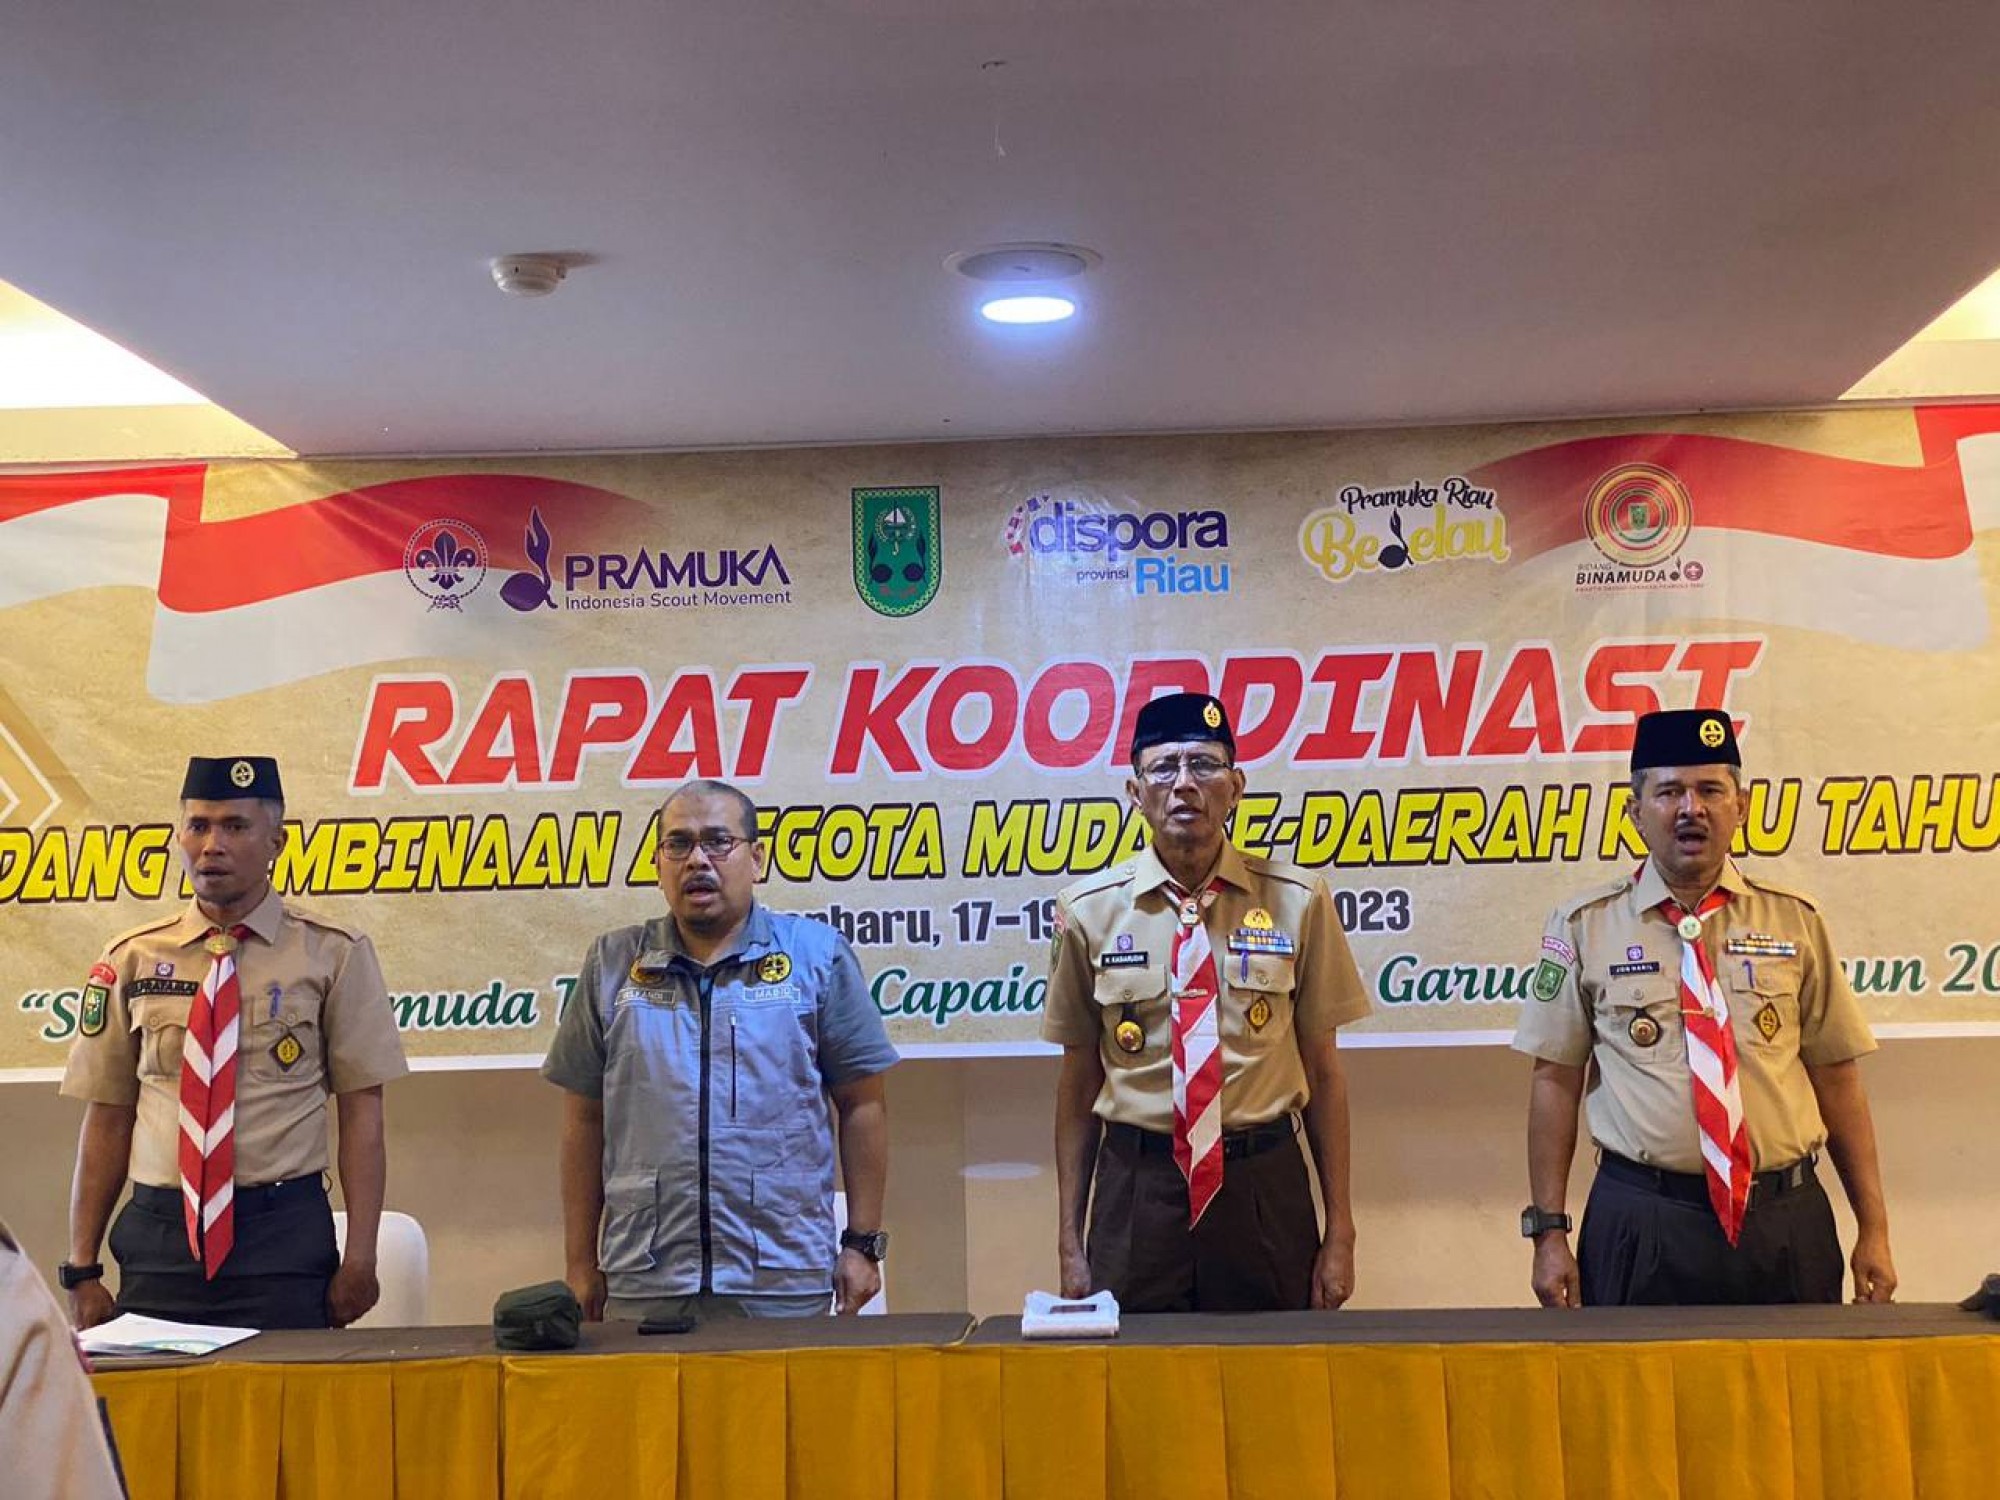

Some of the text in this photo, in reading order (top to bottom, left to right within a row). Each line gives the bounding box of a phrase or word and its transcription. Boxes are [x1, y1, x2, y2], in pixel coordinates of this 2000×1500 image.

[1340, 477, 1498, 515] Pramuka Riau
[1029, 501, 1228, 562] dispora
[565, 544, 791, 592] PRAMUKA
[1076, 557, 1230, 595] provinsi Riau
[1575, 569, 1667, 585] BINAMUDA
[565, 590, 792, 610] Indonesia Scout Movement
[353, 670, 809, 788] RAPAT
[178, 811, 621, 900] MBINAAN
[1222, 783, 1592, 867] E-DAERAH
[1840, 959, 1926, 993] un
